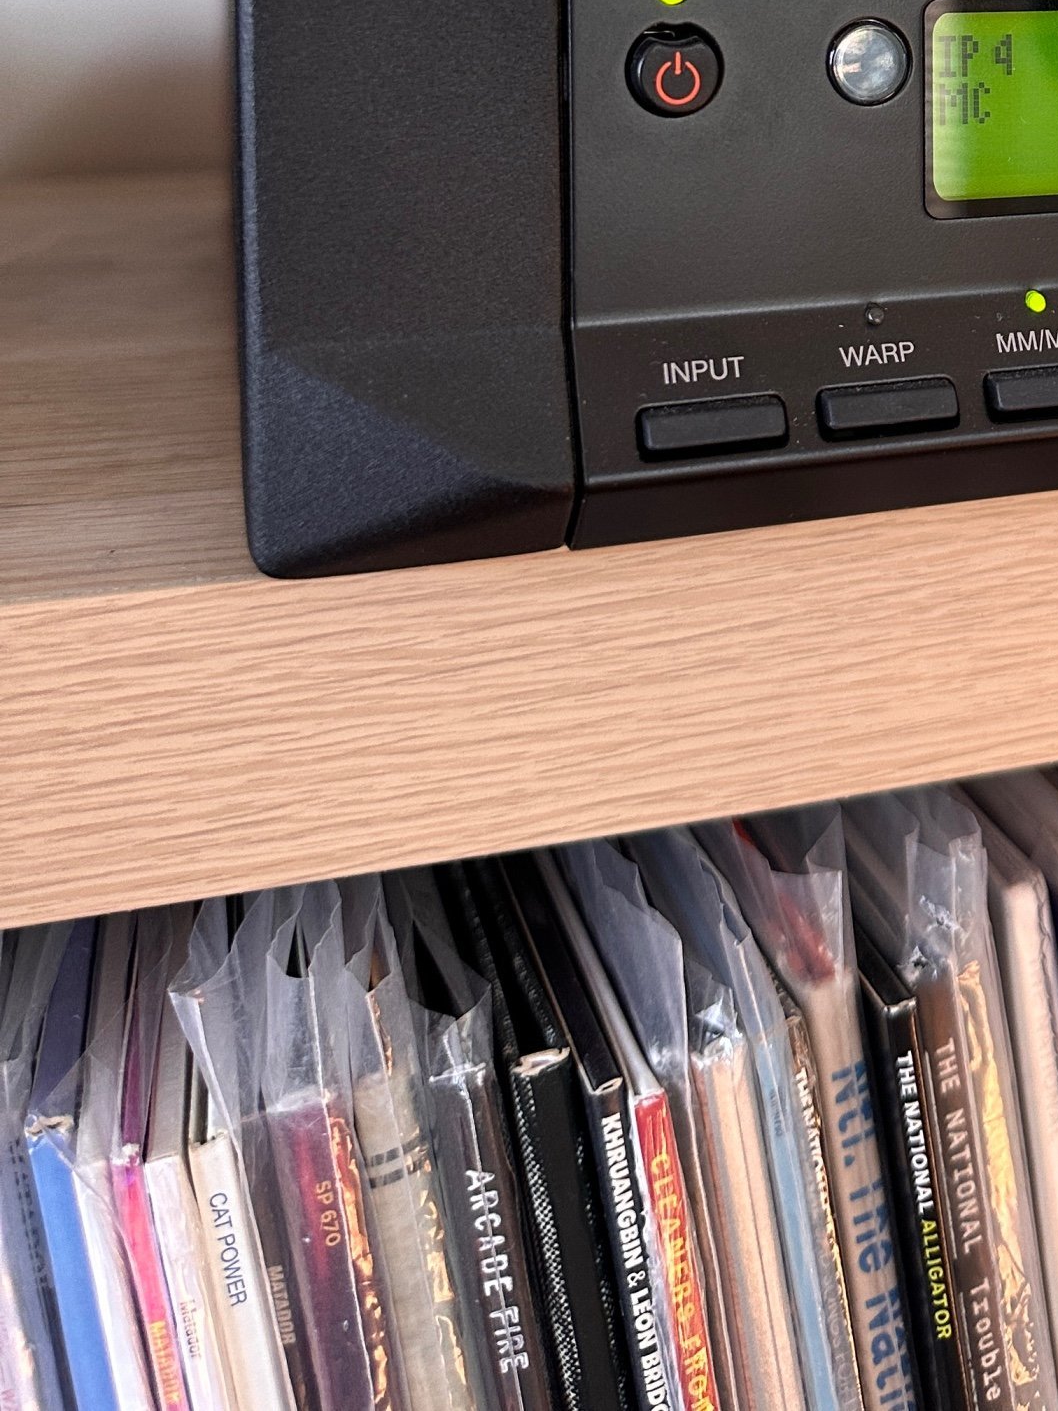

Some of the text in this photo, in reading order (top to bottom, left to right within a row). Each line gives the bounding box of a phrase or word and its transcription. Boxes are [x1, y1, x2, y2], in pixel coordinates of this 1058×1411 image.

[938, 32, 1013, 79] IP 4
[661, 355, 746, 387] INPUT
[839, 340, 916, 369] WARP
[935, 1036, 961, 1094] THE
[315, 1180, 342, 1247] SP 670
[601, 1112, 644, 1269] KHRUANGBIN
[896, 1050, 953, 1340] THE NATIONAL ALLIGATOR
[944, 1107, 983, 1256] NATIONAL
[209, 1192, 249, 1308] CAT POWER
[465, 1169, 531, 1375] ARCADE FIRE
[651, 1153, 700, 1325] CLEANERS
[267, 1264, 296, 1346] MATADOR
[626, 1270, 646, 1288] &
[630, 1287, 658, 1350] LEON
